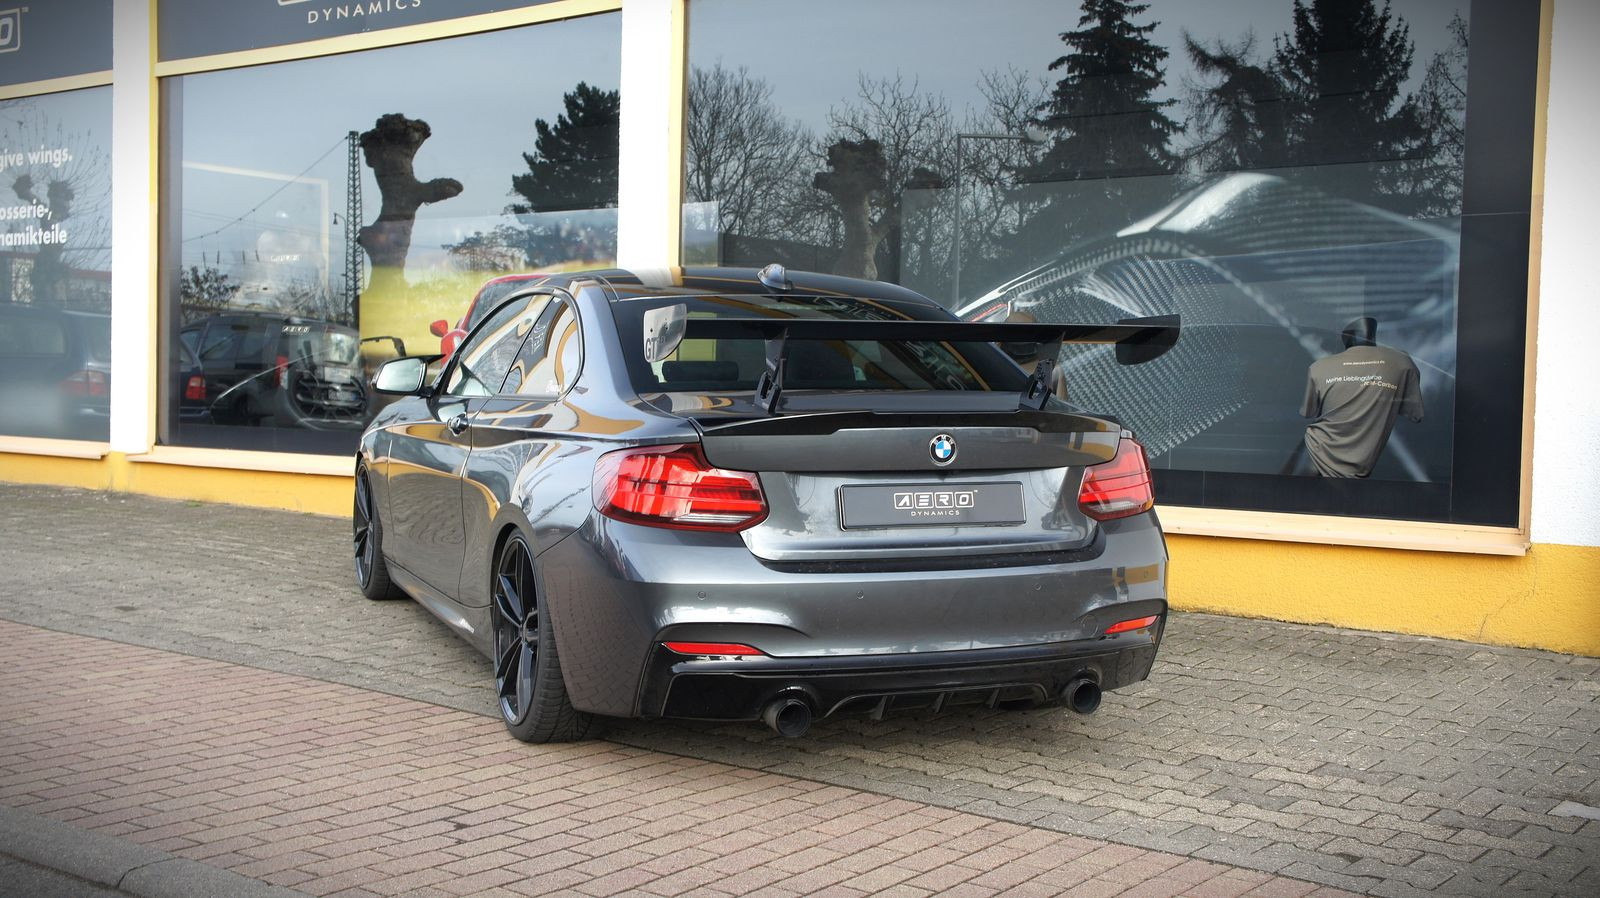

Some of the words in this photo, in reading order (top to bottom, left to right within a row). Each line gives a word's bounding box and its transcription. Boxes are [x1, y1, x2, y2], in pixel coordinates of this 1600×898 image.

[307, 0, 421, 24] DYNAMICS
[28, 145, 73, 168] wings.
[1325, 376, 1342, 384] Meine
[895, 492, 973, 509] AERO
